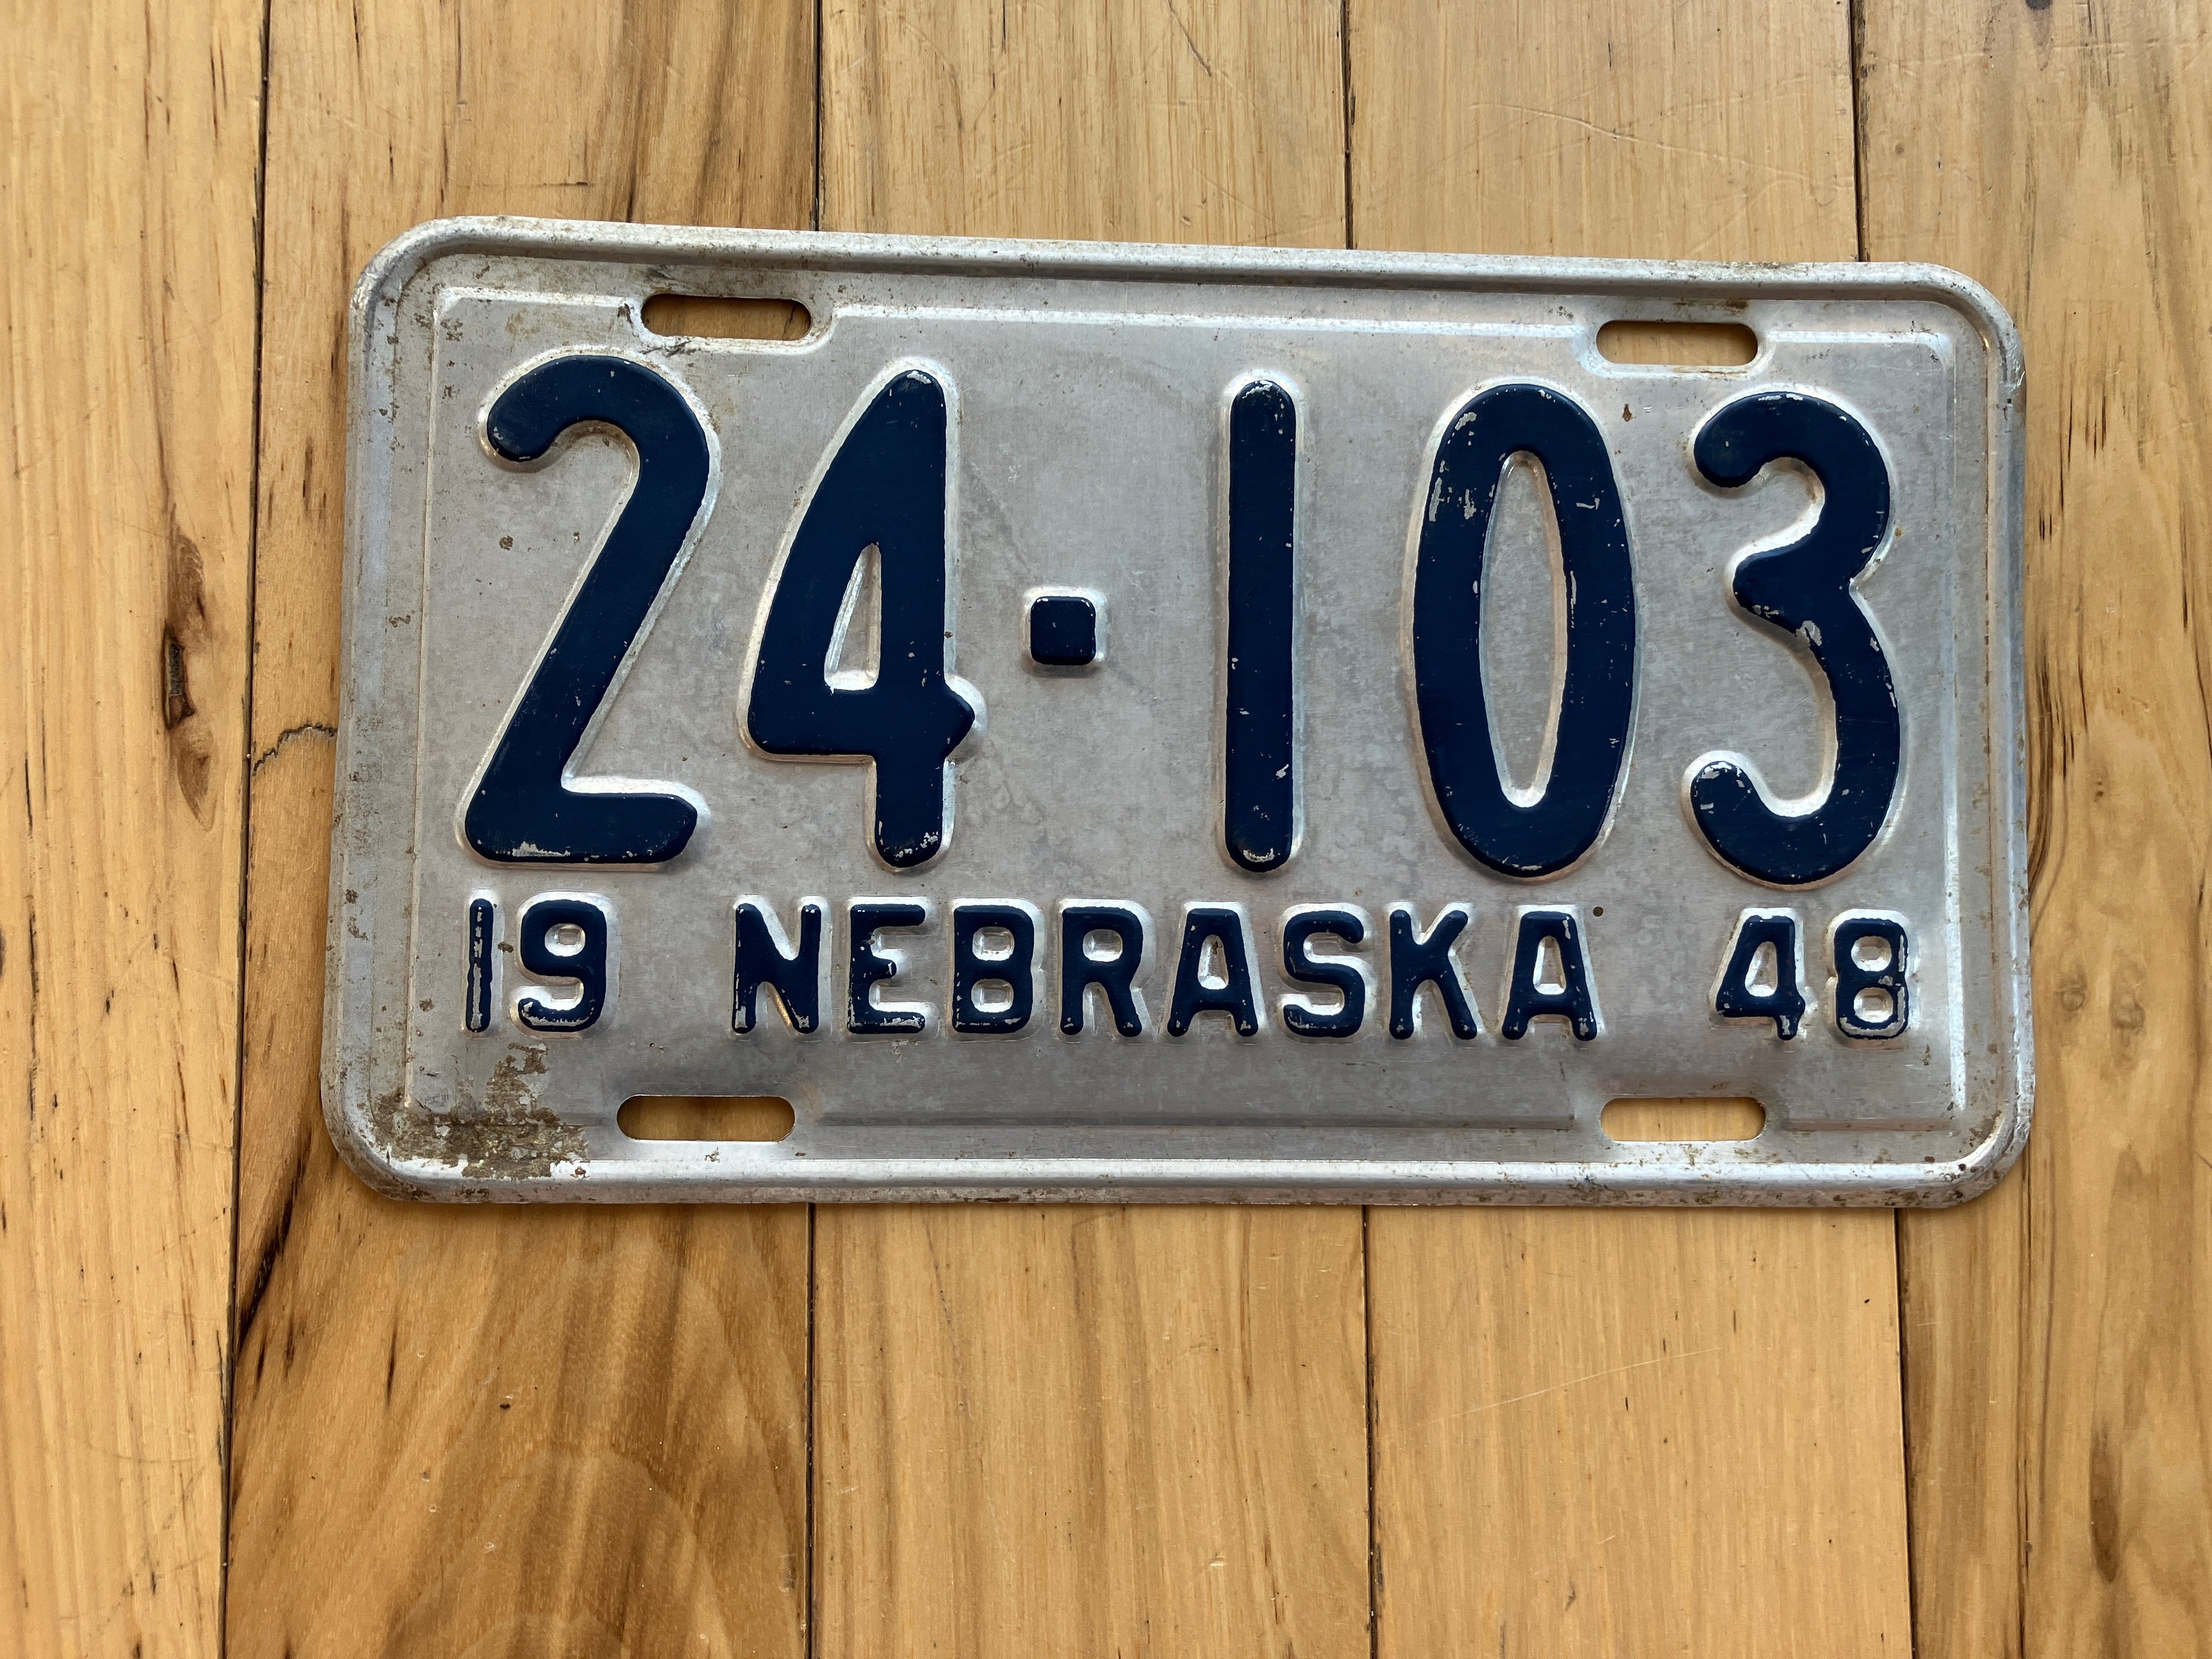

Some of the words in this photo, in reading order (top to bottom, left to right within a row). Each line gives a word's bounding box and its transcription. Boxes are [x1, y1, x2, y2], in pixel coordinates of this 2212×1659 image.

[466, 896, 608, 1031] 19
[731, 900, 1604, 1042] NEBRASKA
[1715, 911, 1910, 1040] 48
